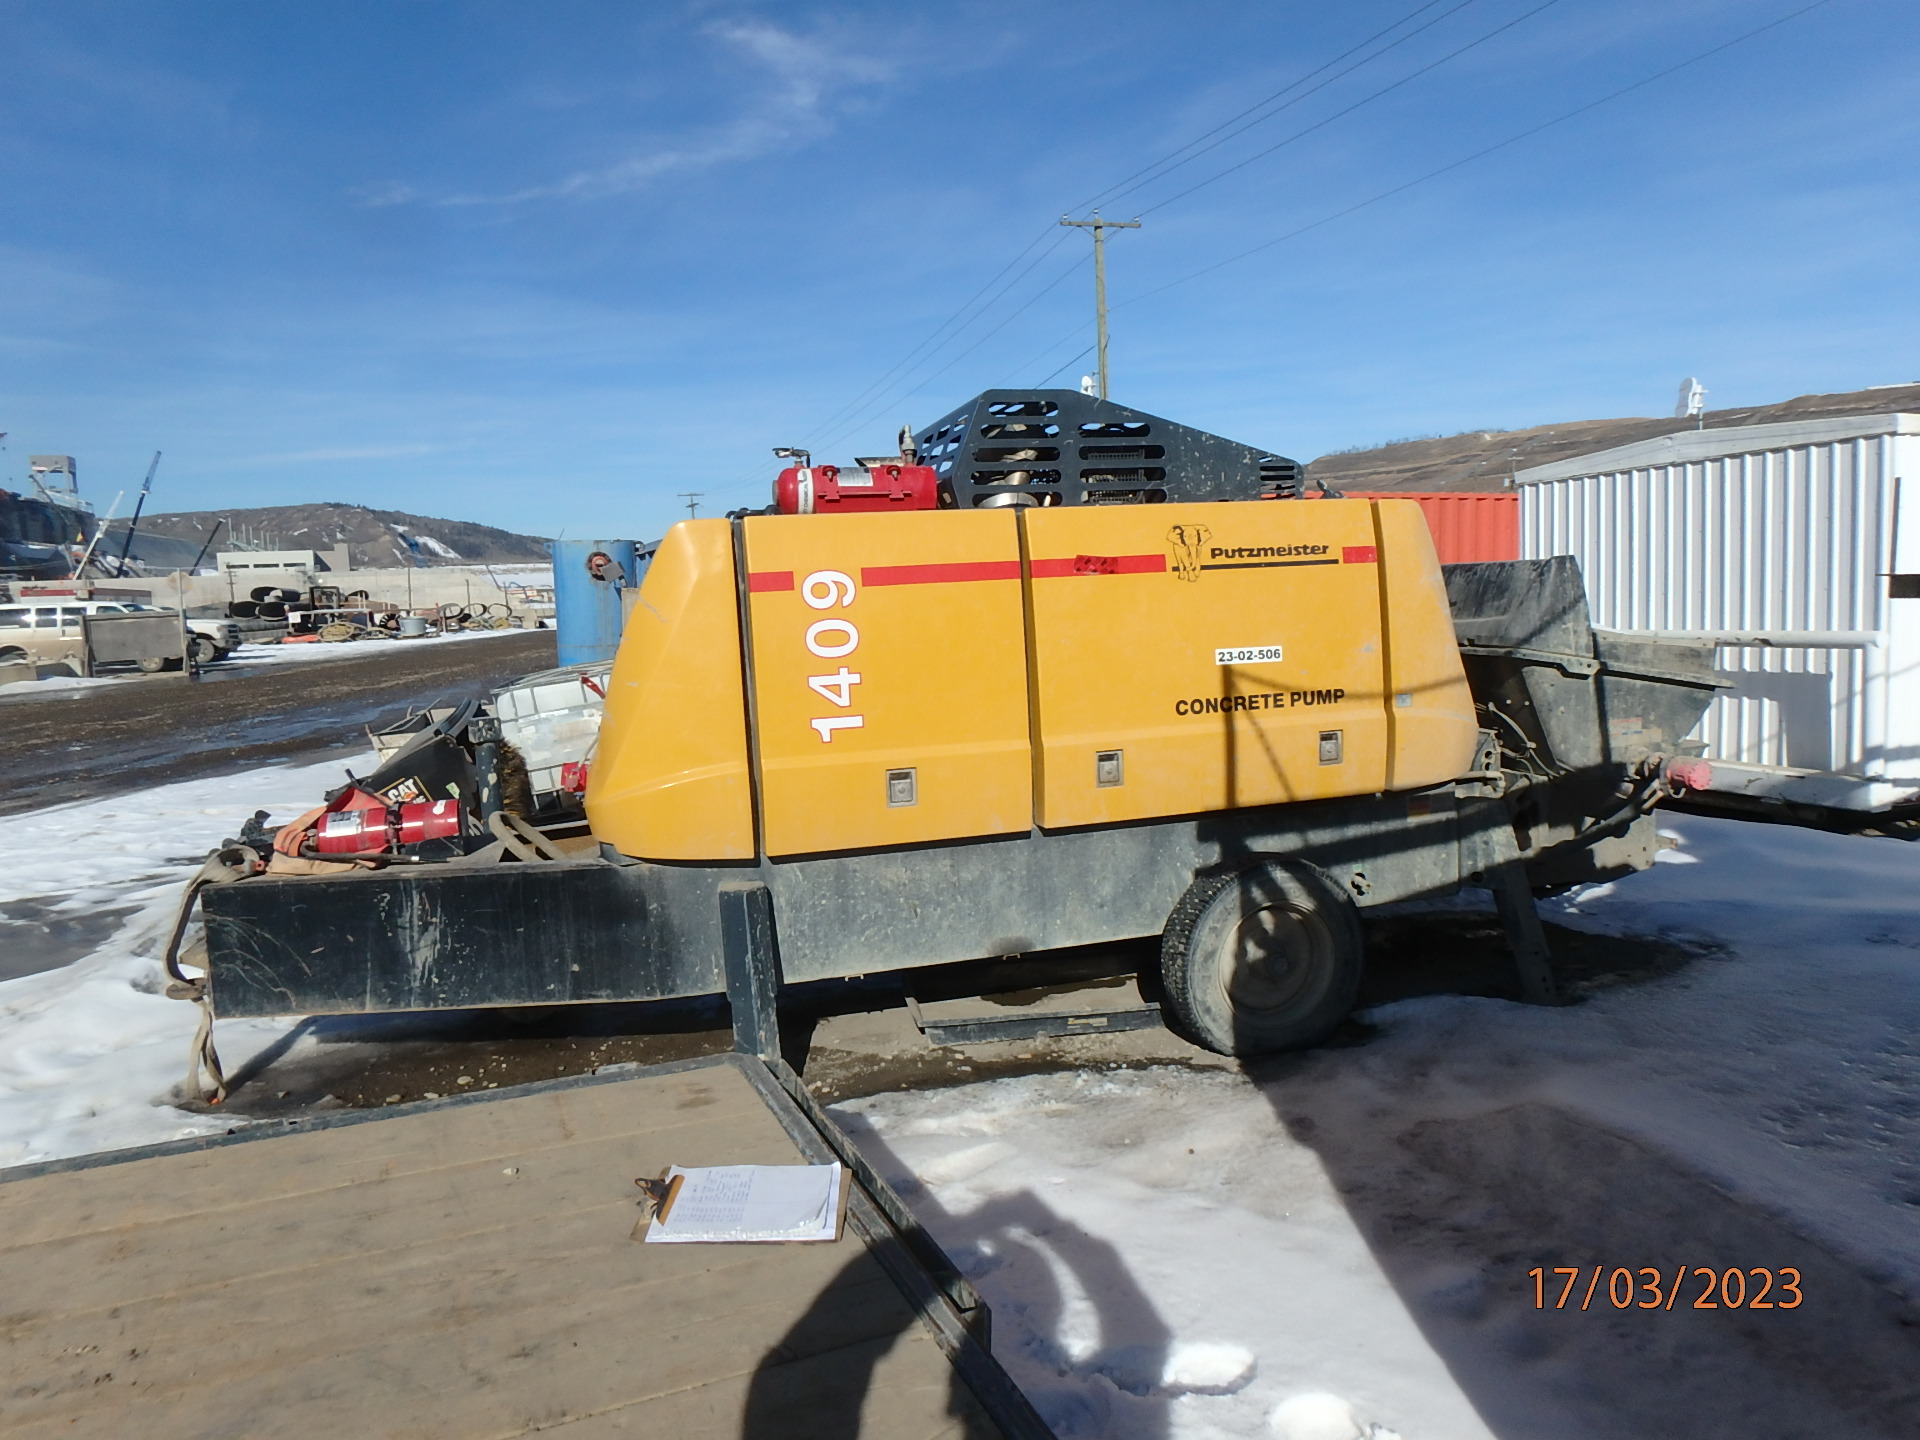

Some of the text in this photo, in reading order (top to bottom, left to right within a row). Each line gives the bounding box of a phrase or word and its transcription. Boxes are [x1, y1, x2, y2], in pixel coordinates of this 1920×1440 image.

[1210, 543, 1329, 560] Putzmeister
[801, 569, 864, 744] 1409
[1217, 648, 1282, 663] 23-02-506
[1175, 688, 1345, 716] CONCRETE PUMP
[387, 778, 419, 803] CAT
